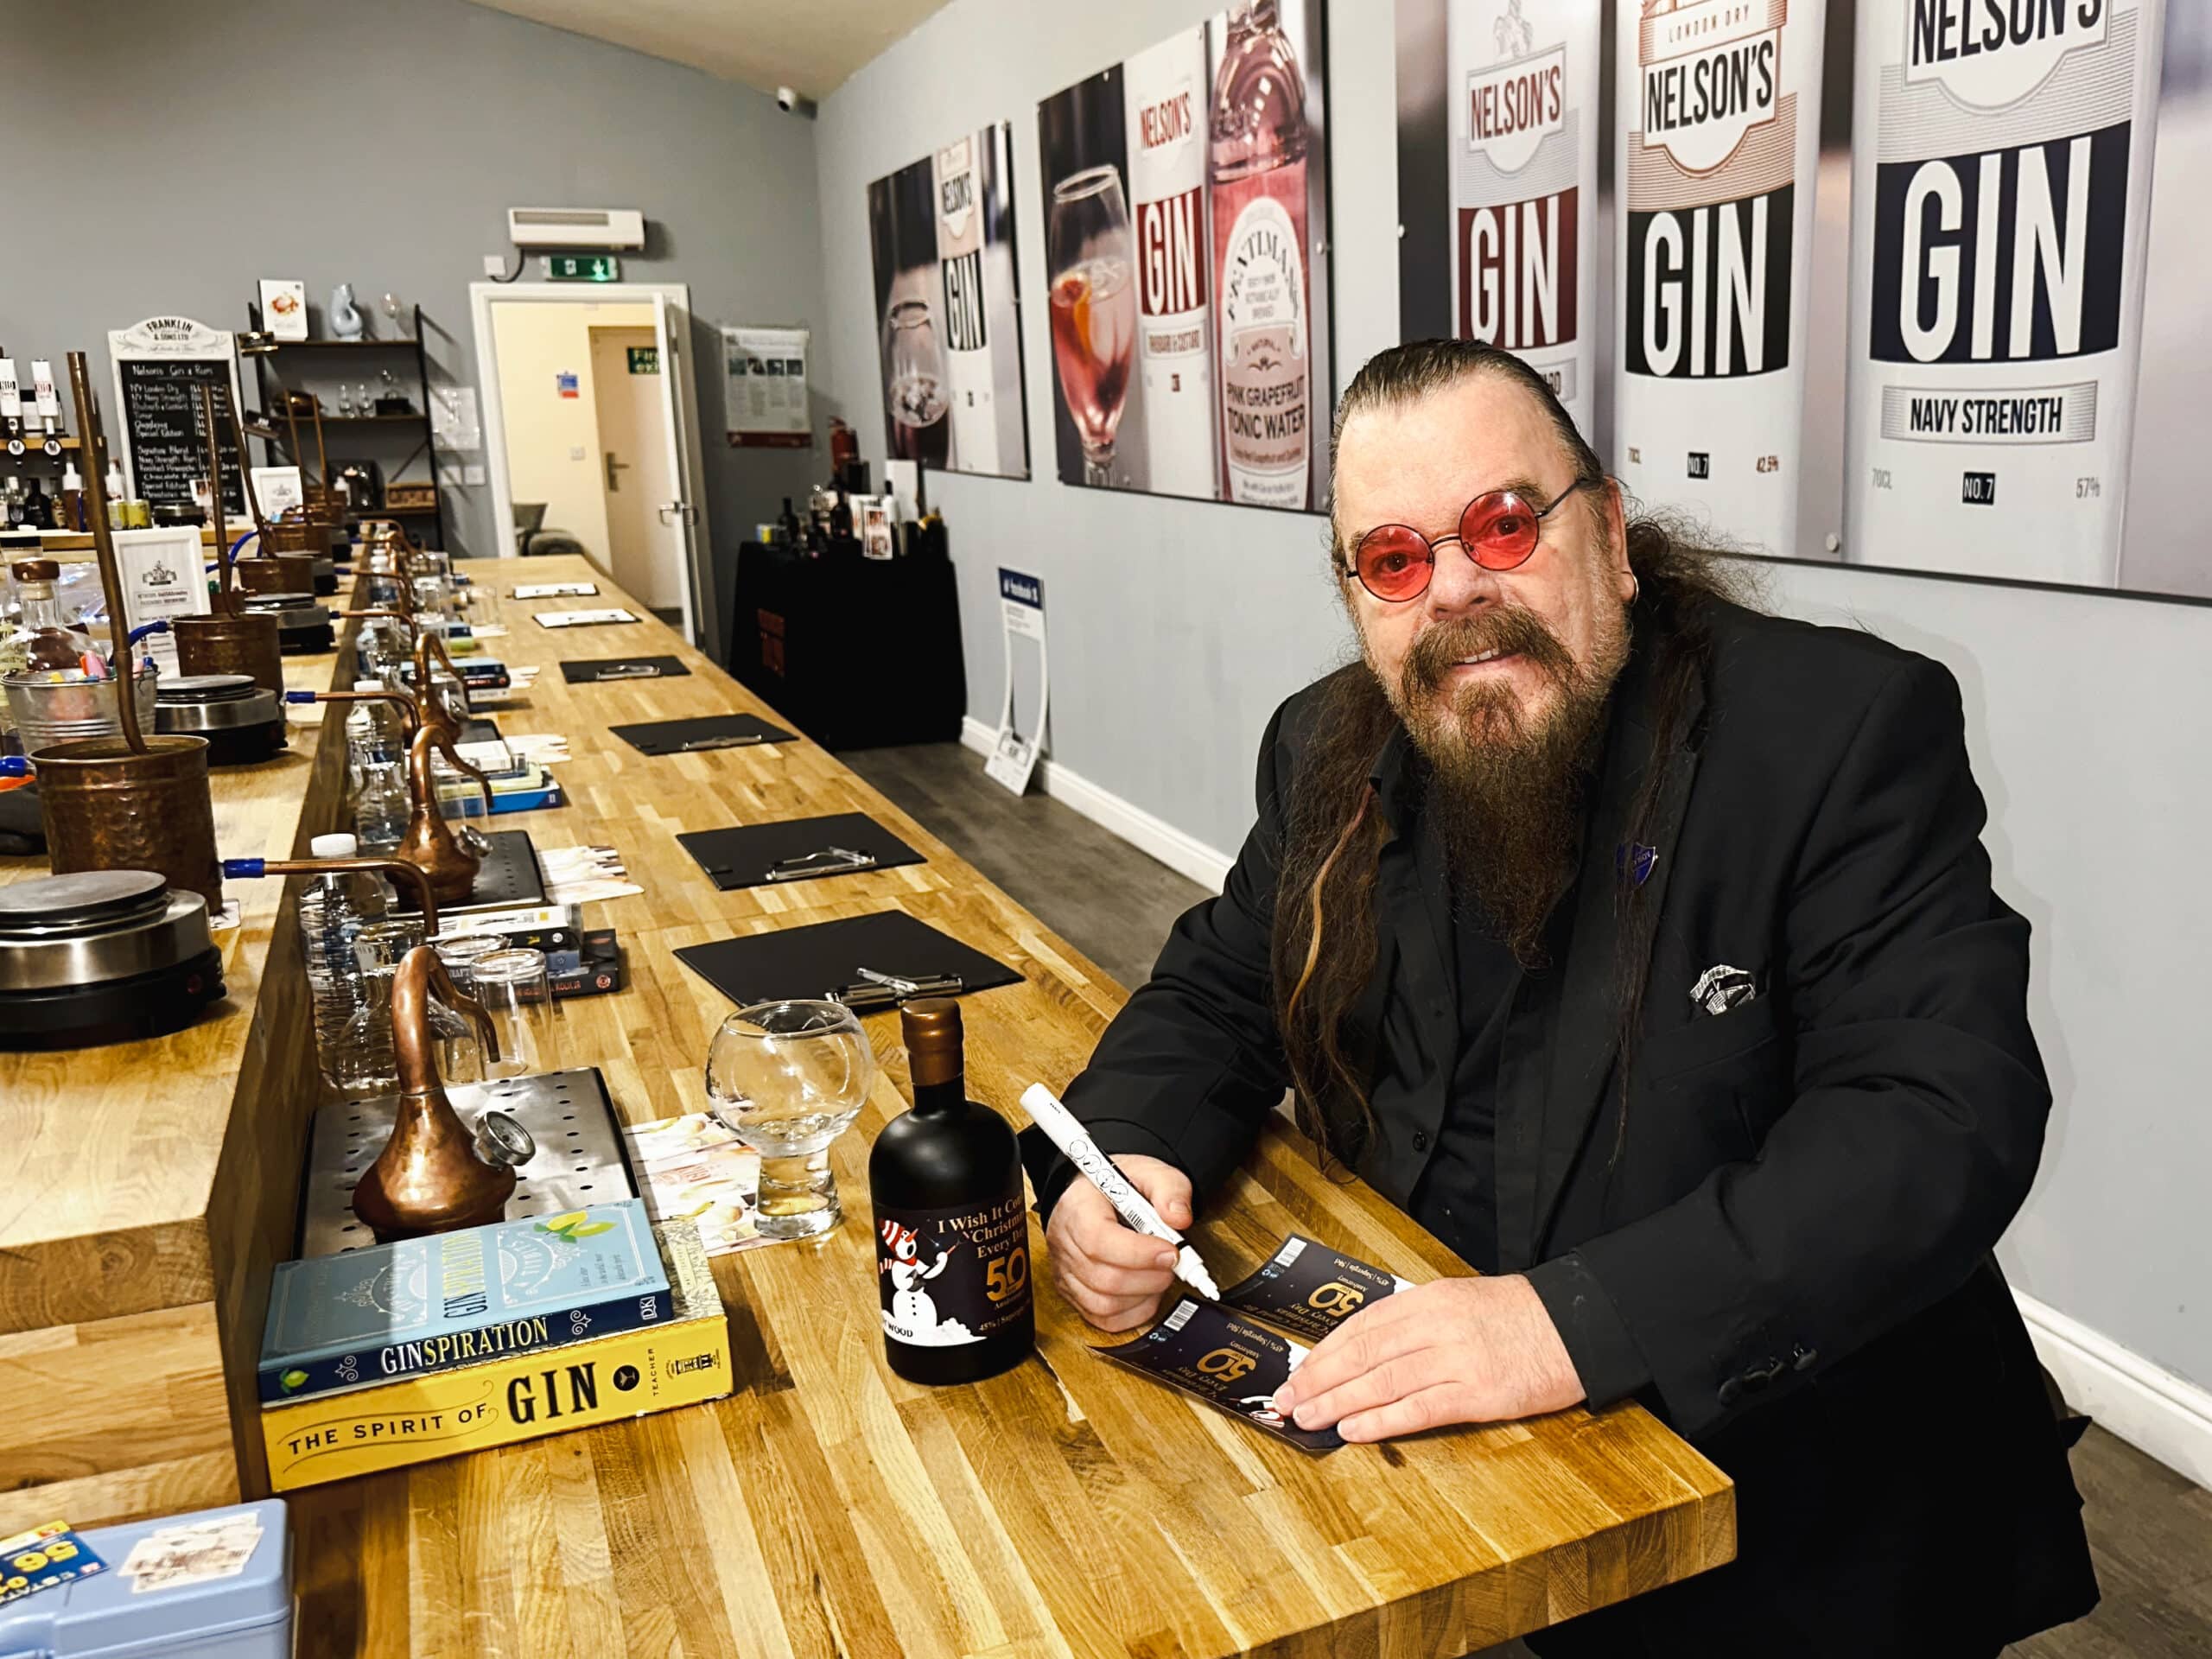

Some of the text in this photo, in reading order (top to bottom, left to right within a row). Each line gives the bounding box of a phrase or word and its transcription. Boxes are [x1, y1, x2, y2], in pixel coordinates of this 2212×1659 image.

[1669, 4, 1749, 42] LONDON DRY
[1471, 65, 1560, 141] NELSON'S
[1648, 40, 1773, 133] NELSON'S
[1141, 92, 1191, 149] NELSON'S
[1145, 192, 1198, 316] GIN
[1471, 194, 1559, 348] GIN
[1900, 136, 2091, 362] GIN
[947, 251, 982, 351] GIN
[1643, 194, 1768, 377] GIN
[146, 319, 193, 332] FRANKLIN
[1246, 375, 1305, 407] GRAPEFRUIT
[1910, 397, 2063, 434] NAVY STRENGTH
[1228, 404, 1306, 440] TONIC WATER
[2076, 477, 2100, 499] 57%
[938, 1220, 946, 1233] I
[949, 1212, 988, 1231] Wish
[991, 1207, 1002, 1220] It
[442, 1230, 488, 1319] GINSPIRATION
[976, 1239, 1010, 1258] Every
[987, 1247, 1027, 1301] 50
[1308, 1281, 1363, 1317] 50
[380, 1317, 549, 1375] GINSPIRATION
[888, 1322, 913, 1337] WOOD
[648, 1349, 659, 1396] TEACHER
[1196, 1347, 1256, 1382] 50
[507, 1362, 598, 1425] GIN
[289, 1403, 486, 1455] THE SPIRIT OF
